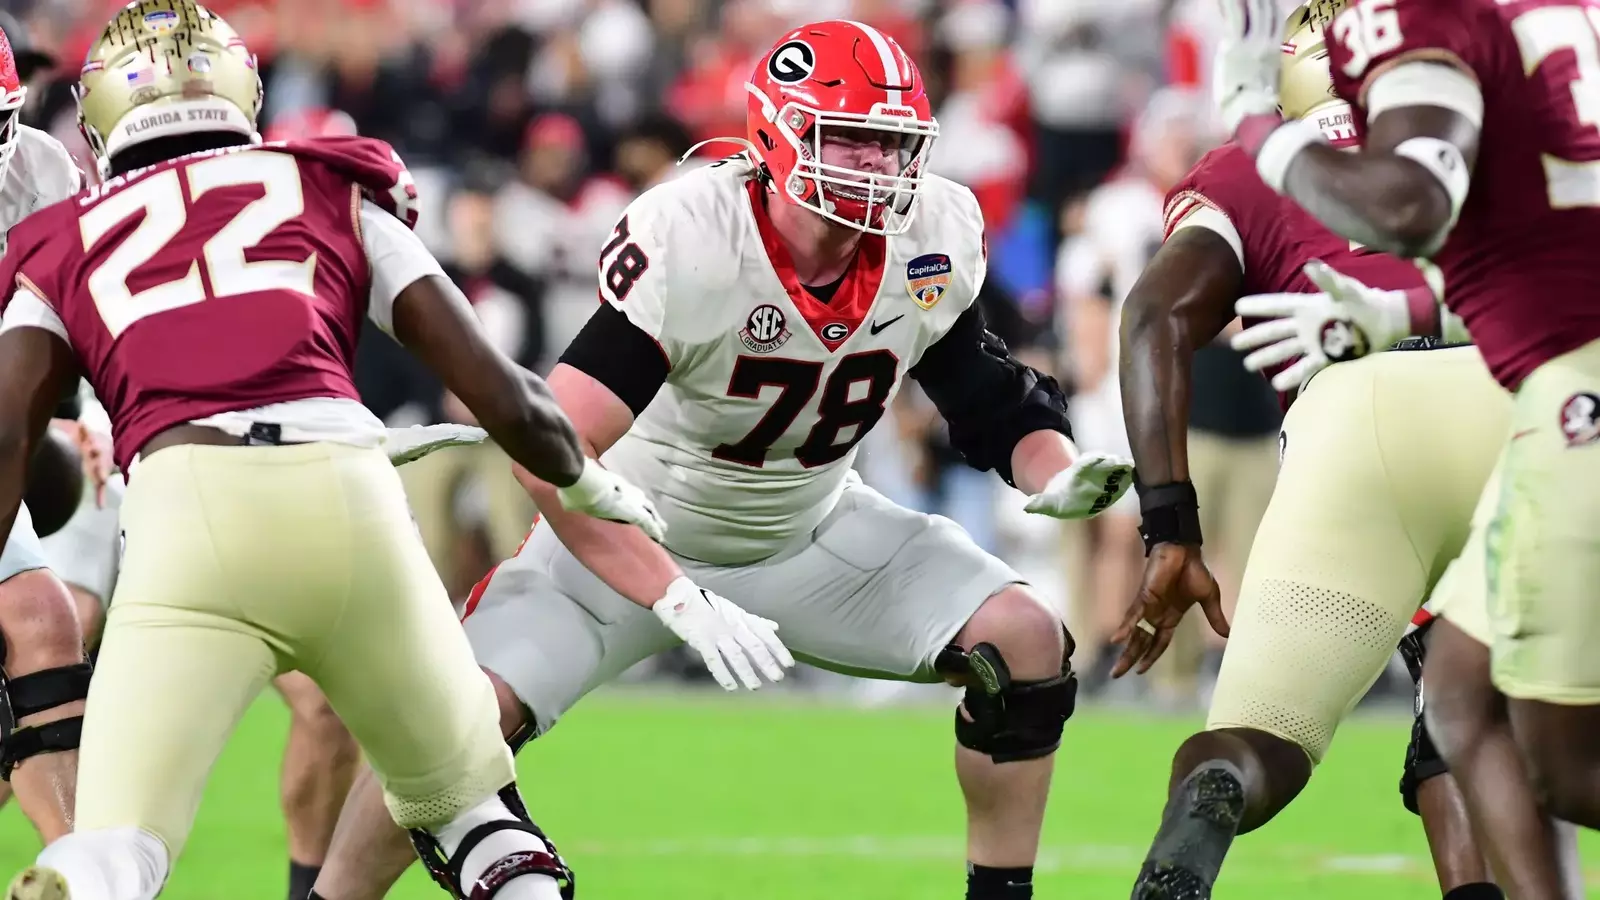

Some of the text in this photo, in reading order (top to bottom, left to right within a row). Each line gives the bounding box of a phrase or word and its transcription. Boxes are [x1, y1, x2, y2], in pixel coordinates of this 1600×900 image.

[1331, 0, 1404, 78] 36
[769, 41, 813, 82] G
[125, 109, 228, 136] FLORIDA STATE
[880, 107, 913, 117] DAWGS
[78, 150, 317, 339] 22
[599, 213, 649, 301] 78
[750, 306, 783, 340] SEC
[744, 336, 783, 352] GRADUATE
[711, 348, 900, 469] 78
